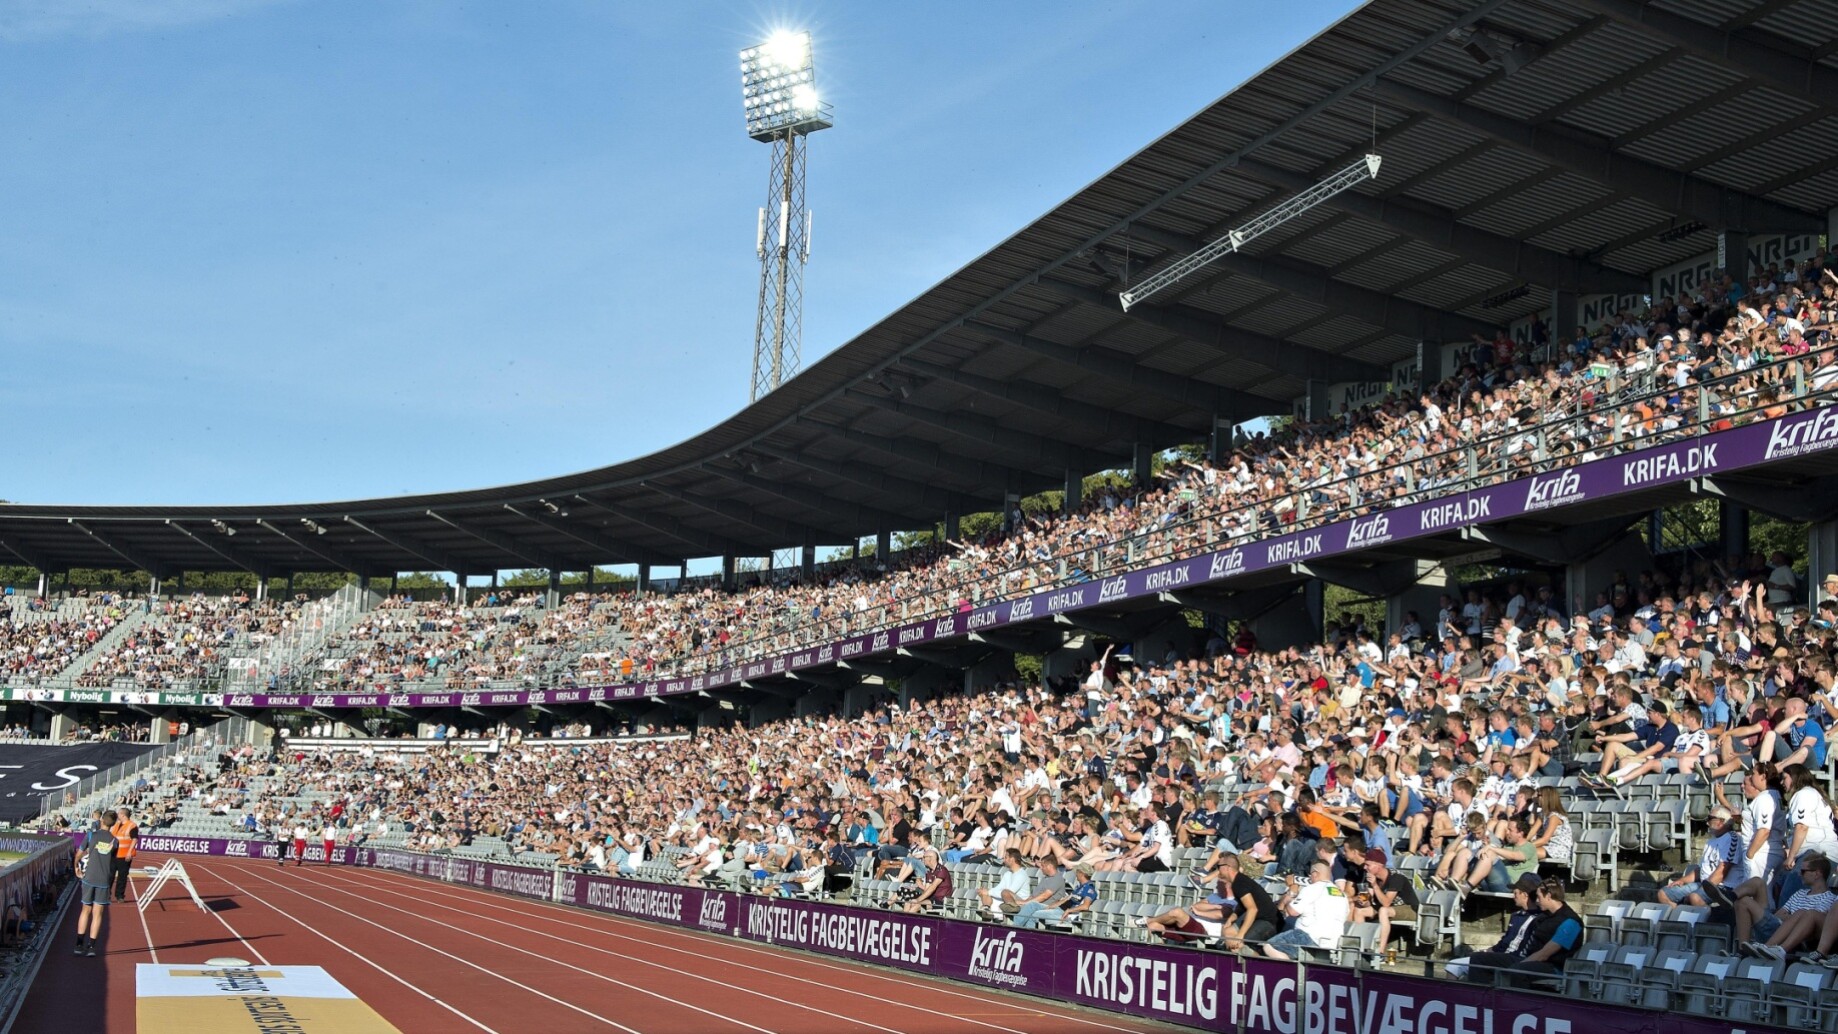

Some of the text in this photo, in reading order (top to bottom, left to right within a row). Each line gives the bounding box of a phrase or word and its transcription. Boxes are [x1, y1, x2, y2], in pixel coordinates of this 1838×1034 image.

[1764, 407, 1838, 460] krifa
[1624, 443, 1718, 486] KRIFA.DK
[1524, 468, 1581, 511] krifa
[1420, 495, 1491, 530] KRIFA.DK
[1346, 513, 1389, 549] krifa
[1267, 534, 1322, 563] KRIFA.DK
[1209, 547, 1243, 579] krifa
[1099, 575, 1127, 603] krifa
[1146, 565, 1190, 590] KRIFA.DK
[1009, 597, 1033, 622] krifa
[1048, 589, 1083, 611] KRIFA.DK
[934, 616, 955, 638] krifa
[966, 609, 997, 629] KRIFA.DK
[899, 625, 924, 643] KRIFA.DK
[841, 640, 863, 656] KRIFA.DK
[70, 690, 103, 702] Nybolig
[165, 693, 196, 705] Nybolig
[267, 697, 299, 705] KRIFA.DK
[347, 697, 377, 705] KRIFA.DK
[421, 695, 450, 704] KRIFA.DK
[140, 838, 210, 853] FAGBEVÆGELSE
[225, 840, 247, 855] krifa
[587, 881, 683, 920] KRISTELIG FAGBEVÆGELSE
[699, 891, 726, 925] krifa
[748, 903, 931, 965] KRISTELIG FAGBEVÆGELSE
[968, 926, 1024, 975] krifa
[1076, 950, 1217, 1020] KRISTELIG
